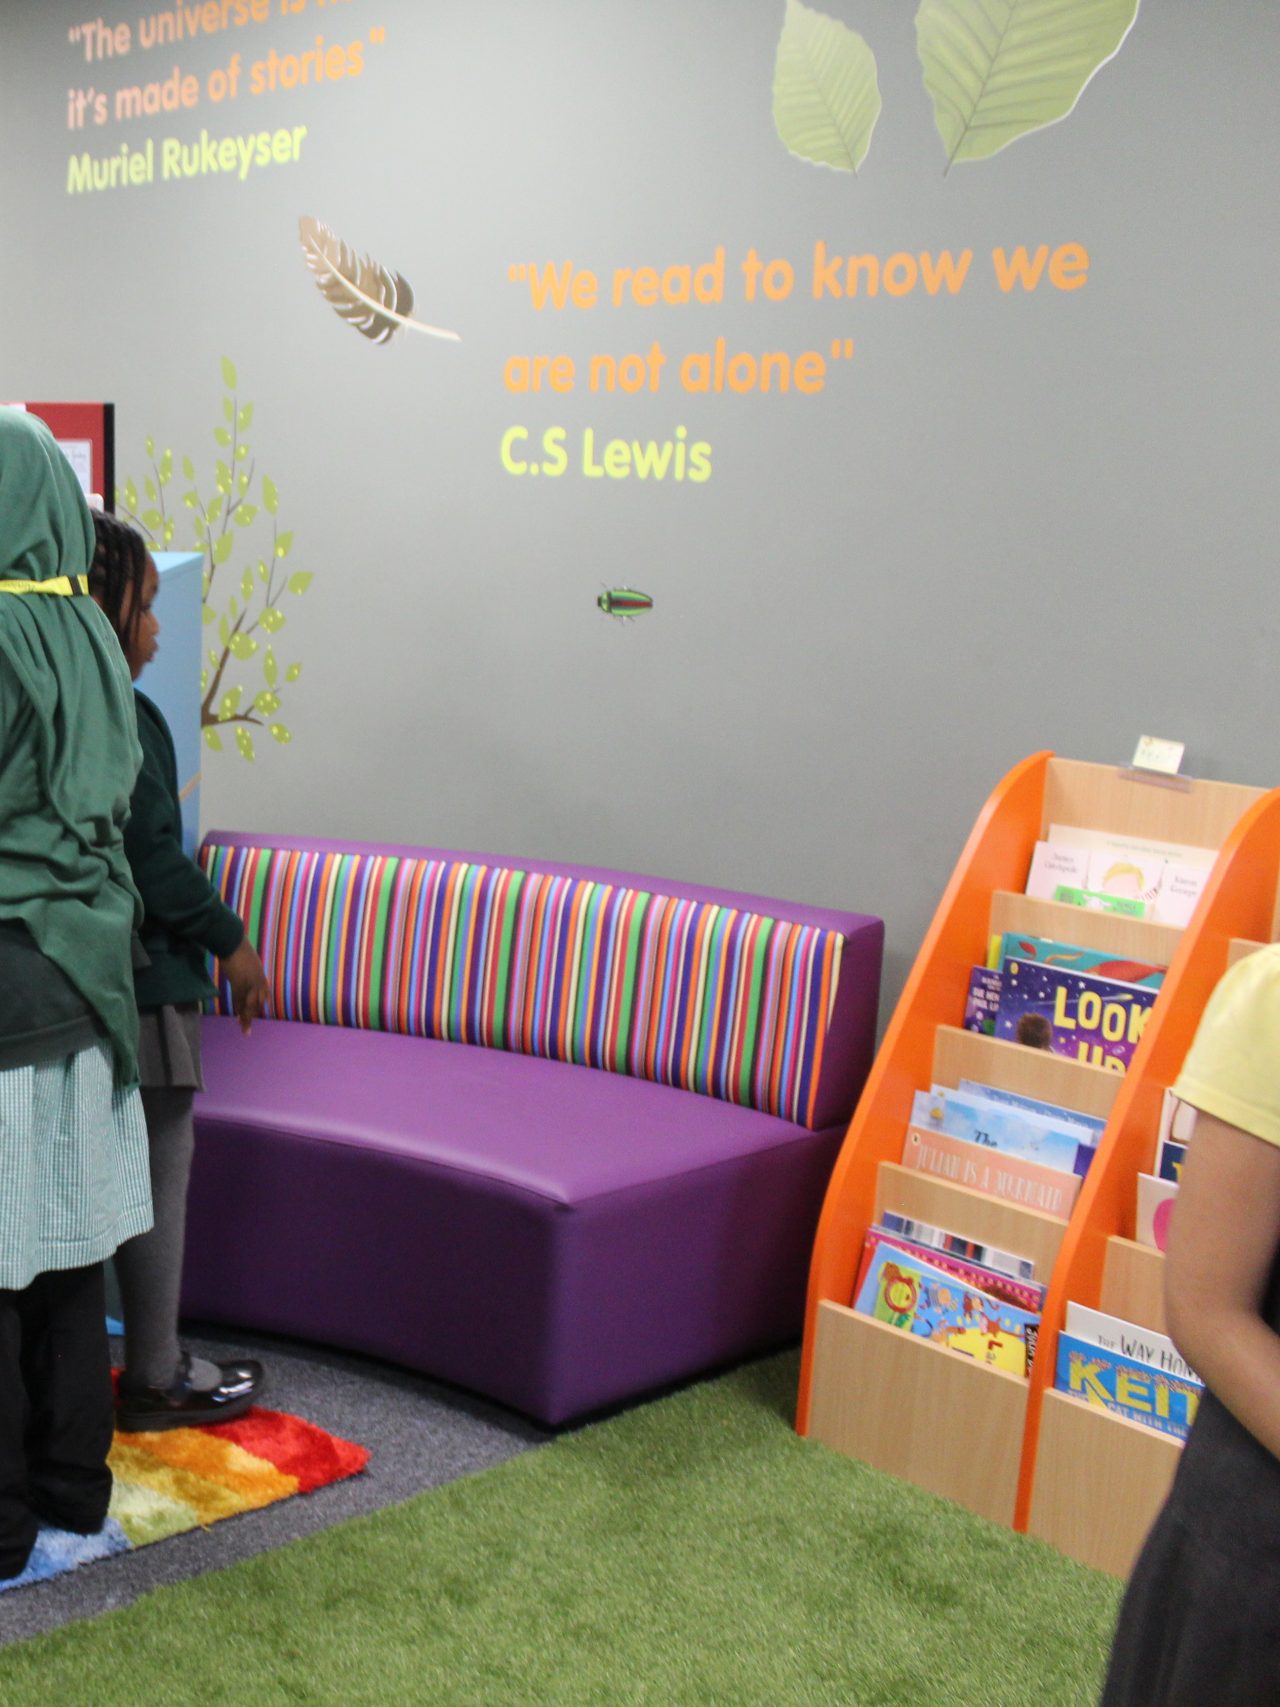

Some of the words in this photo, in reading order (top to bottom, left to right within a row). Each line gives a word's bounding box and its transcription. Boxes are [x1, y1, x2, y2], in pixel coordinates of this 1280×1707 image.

[68, 17, 132, 63] "The
[138, 0, 270, 49] universe
[67, 86, 109, 131] it's
[114, 64, 200, 121] made
[207, 52, 241, 103] of
[249, 24, 387, 96] stories"
[66, 136, 155, 194] Muriel
[161, 124, 308, 182] Rukeyser
[507, 259, 599, 311] "We
[611, 245, 726, 308] read
[740, 246, 796, 302] to
[812, 239, 973, 299] know
[991, 240, 1091, 293] we
[502, 353, 576, 394] are
[587, 340, 668, 394] not
[679, 335, 855, 395] alone"
[500, 424, 569, 478] C.S
[582, 424, 713, 483] Lewis
[1053, 985, 1155, 1045] LOOK
[980, 1166, 991, 1190] A
[1120, 1333, 1155, 1362] WAY
